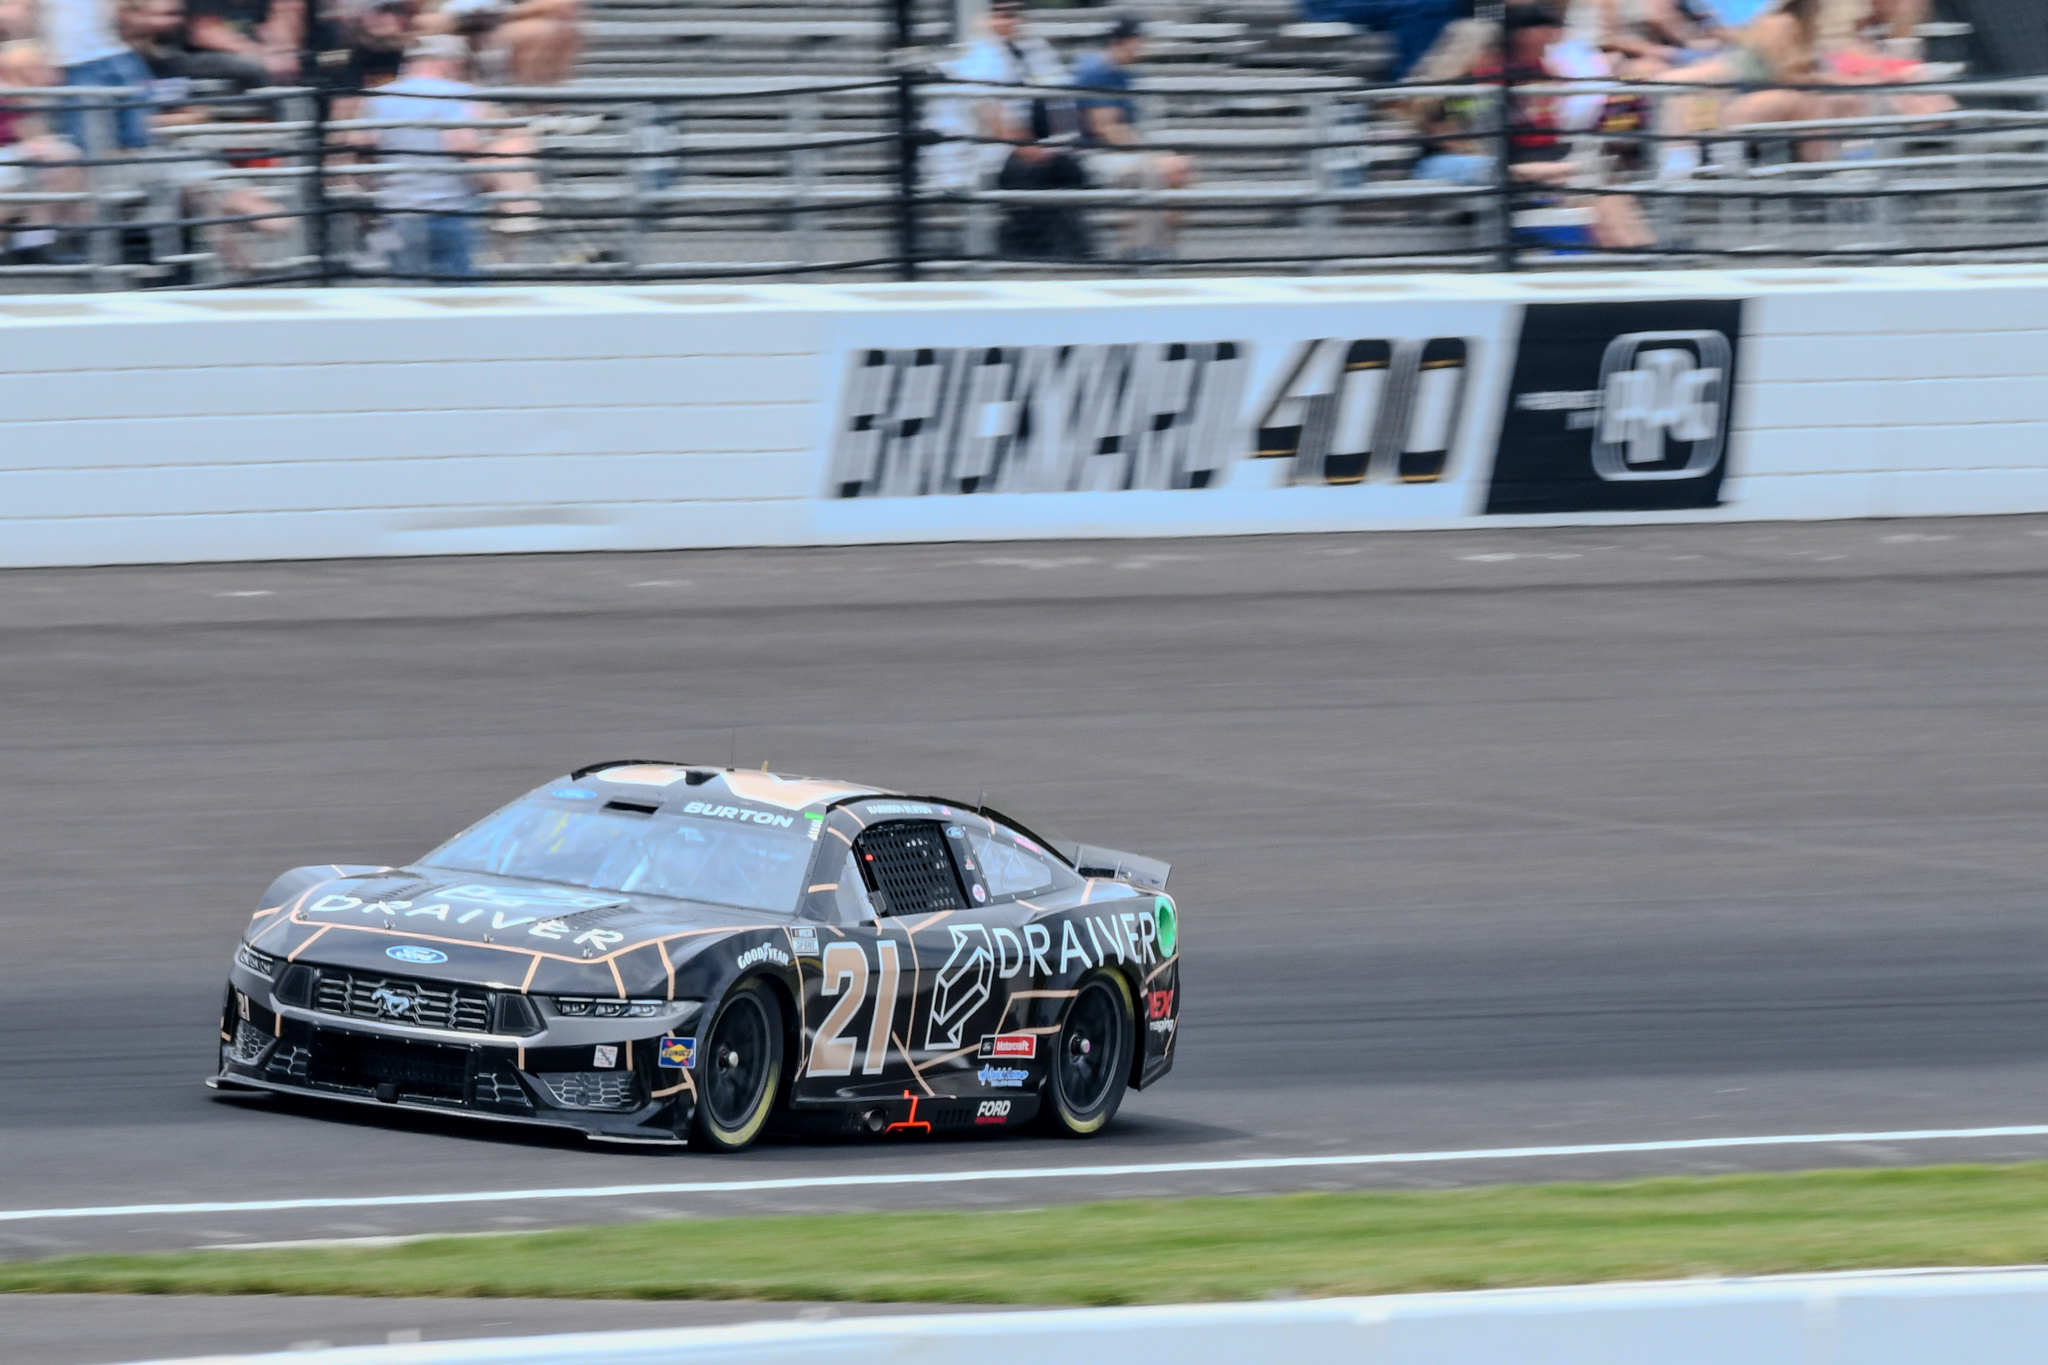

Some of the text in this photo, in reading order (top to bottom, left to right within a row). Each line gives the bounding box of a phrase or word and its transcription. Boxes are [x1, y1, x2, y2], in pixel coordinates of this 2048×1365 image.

[1249, 336, 1478, 486] 400
[683, 802, 794, 828] BURTON
[310, 894, 624, 951] DRAIVER
[737, 942, 789, 970] GOODYEAR
[992, 912, 1157, 979] DRAIVER
[806, 939, 900, 1078] 21
[1148, 989, 1174, 1019] EX
[1149, 1017, 1175, 1033] maging
[663, 1048, 692, 1060] SUNOCO
[996, 1040, 1030, 1052] Motorcraft
[976, 1100, 1012, 1117] FORD
